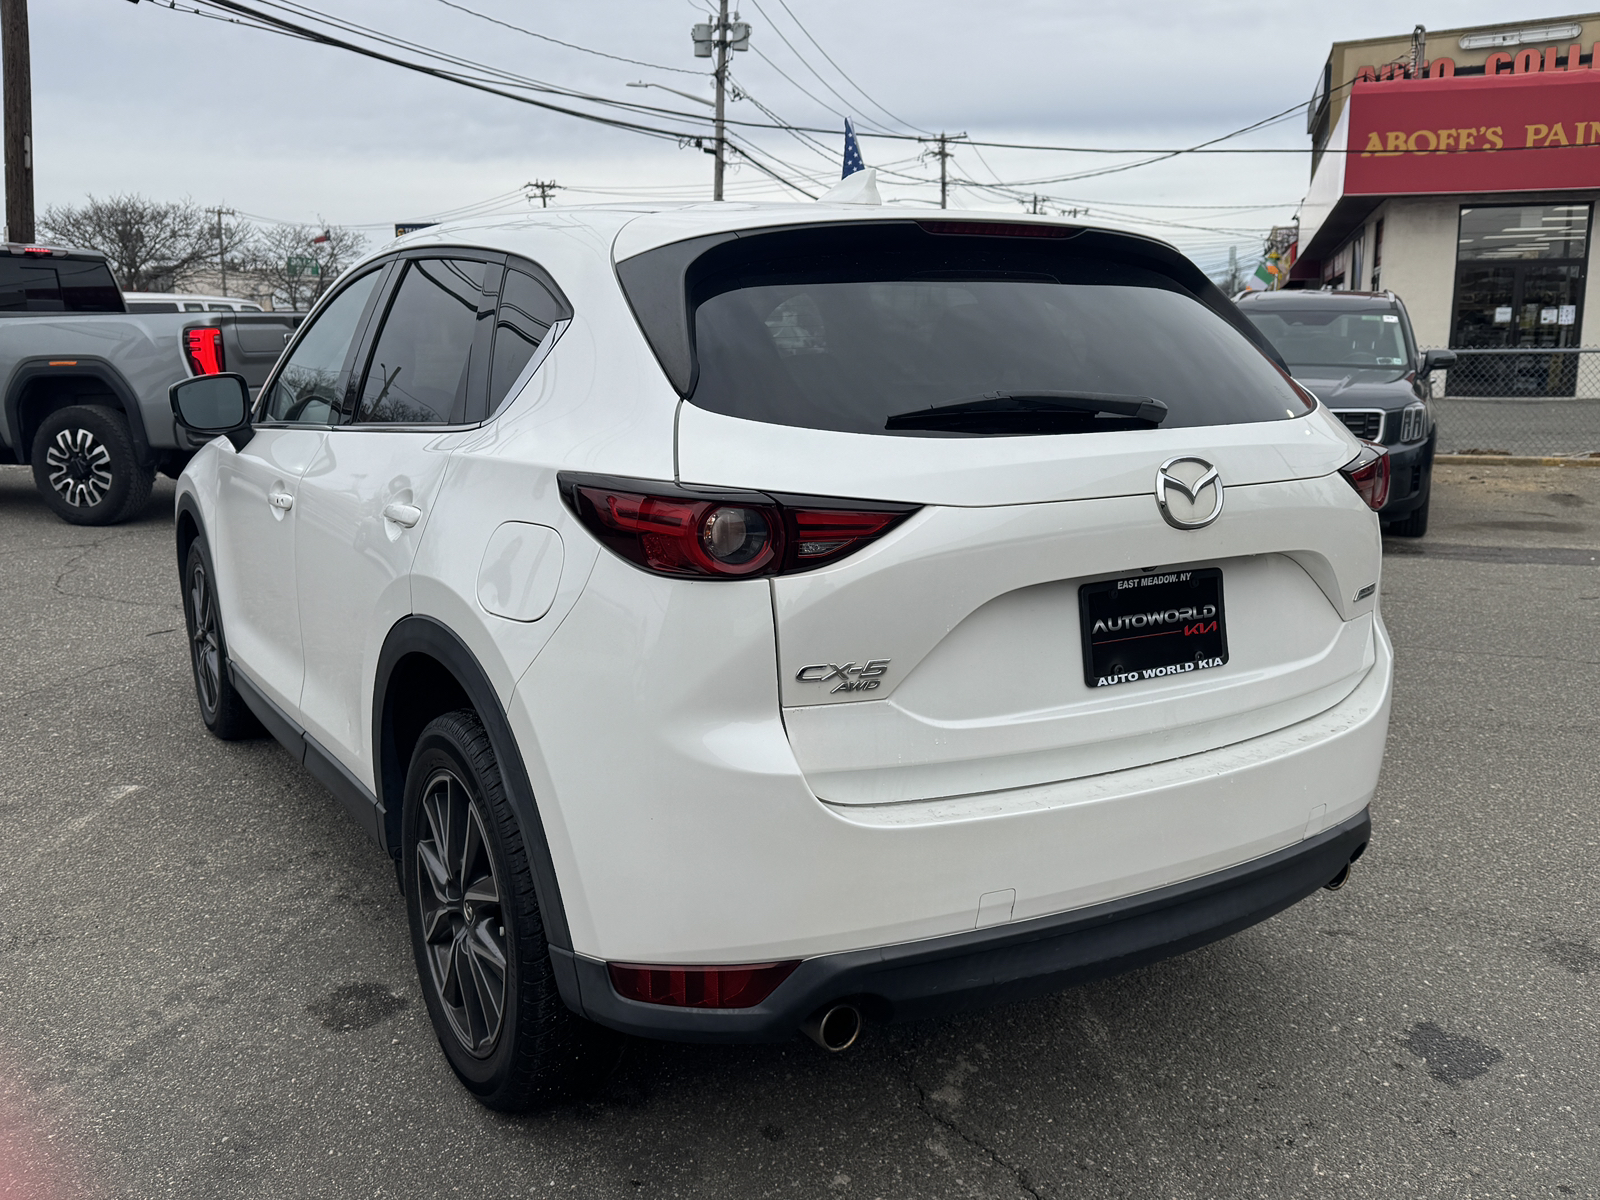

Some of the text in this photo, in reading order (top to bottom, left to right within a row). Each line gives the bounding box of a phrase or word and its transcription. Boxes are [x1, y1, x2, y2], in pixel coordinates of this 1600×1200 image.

[1360, 126, 1504, 157] ABOFF'S
[1117, 579, 1139, 590] EAST
[1180, 572, 1192, 582] NY
[1092, 604, 1216, 634] AUTOWORLD
[795, 658, 891, 683] CX-5
[1097, 657, 1223, 687] AUTO WORLD KIA
[830, 680, 881, 694] AWD
